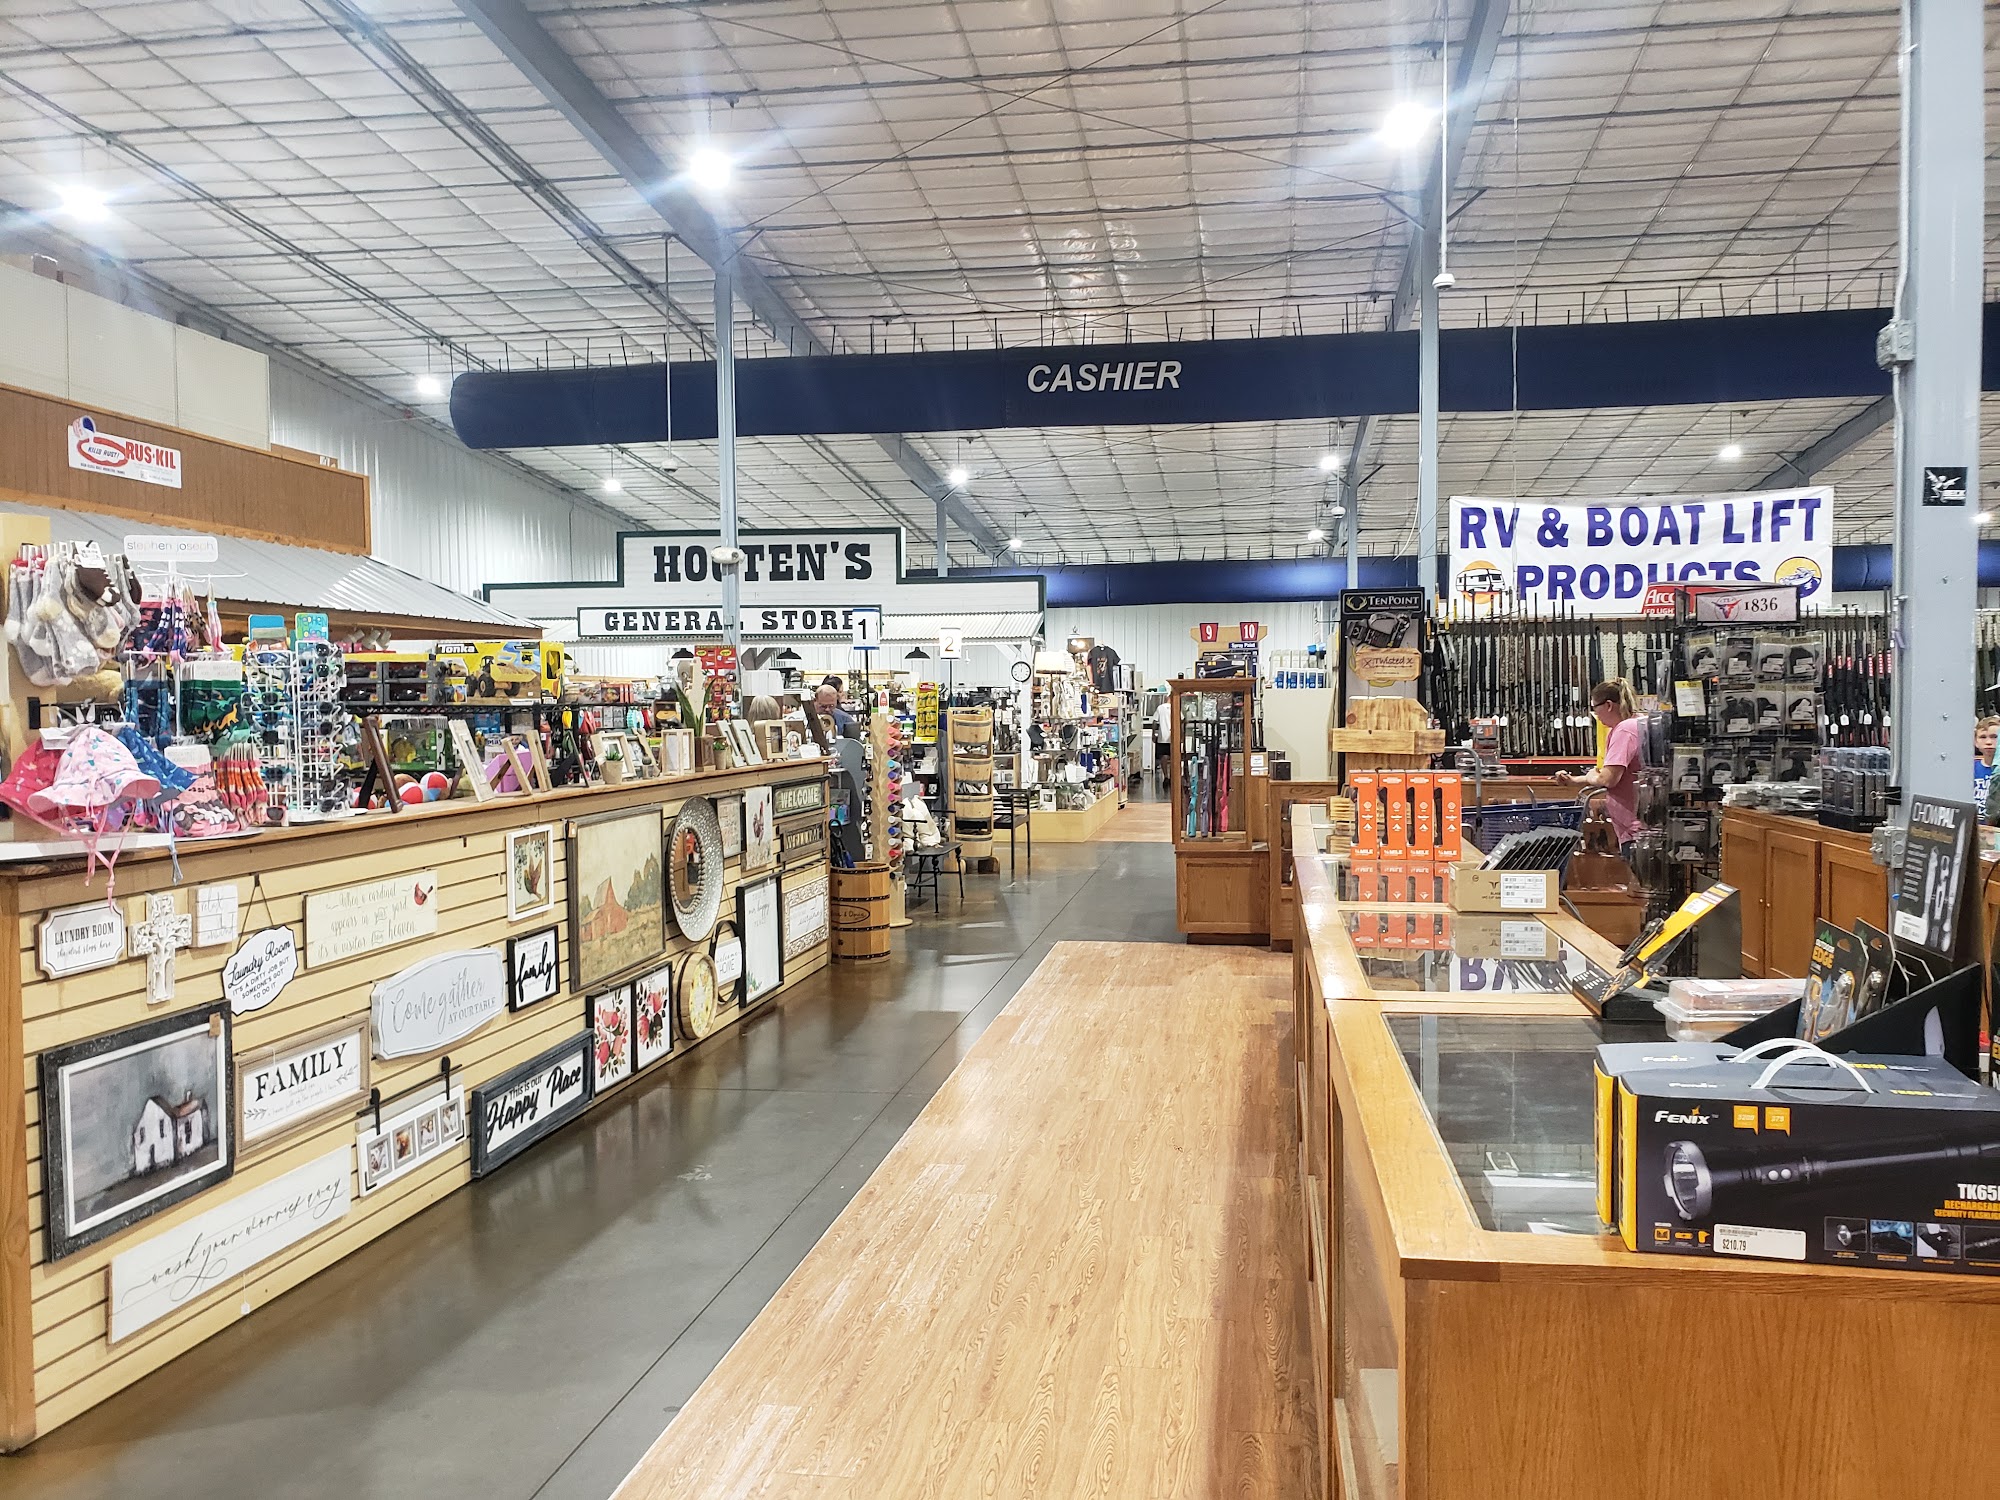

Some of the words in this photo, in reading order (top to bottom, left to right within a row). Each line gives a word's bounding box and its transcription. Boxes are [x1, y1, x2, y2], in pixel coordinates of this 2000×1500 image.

[1027, 360, 1182, 393] CASHIER
[87, 446, 103, 456] KILLS
[1459, 506, 1521, 549] RV
[1536, 507, 1570, 548] &
[1586, 504, 1707, 547] BOAT
[1722, 498, 1821, 544] LIFT
[127, 540, 172, 555] stephen
[1516, 560, 1762, 600] PRODUCTS
[1744, 597, 1778, 612] 1836
[604, 610, 743, 632] GENERA
[857, 618, 867, 640] 1
[1243, 623, 1255, 639] 10
[1205, 625, 1213, 640] 9
[438, 644, 476, 654] Tonka
[944, 636, 954, 652] 2
[1374, 656, 1405, 665] Twisted
[781, 787, 821, 809] WELCOME
[368, 882, 396, 901] cardinal
[54, 926, 90, 946] LAUNDRY
[92, 921, 114, 938] ROOM
[330, 915, 358, 937] appears
[227, 955, 263, 990] Laundry
[265, 940, 291, 962] Room
[1812, 945, 1835, 969] EDGE
[232, 985, 244, 997] IT'S
[250, 971, 266, 985] DIRTY
[267, 963, 278, 975] JOB
[279, 956, 290, 967] BUT
[516, 941, 556, 1003] family
[241, 977, 272, 1000] SOMEONE'S
[272, 968, 284, 979] GOT
[253, 992, 261, 1000] TO
[261, 986, 270, 995] DO
[271, 981, 277, 990] IT
[390, 988, 437, 1034] Come
[438, 967, 485, 1035] gather
[447, 1011, 459, 1025] AT
[459, 1004, 474, 1020] OUR
[474, 996, 496, 1016] TABLE
[255, 1042, 347, 1103] FAMILY
[509, 1083, 524, 1100] This
[524, 1082, 530, 1092] is
[530, 1075, 543, 1089] our
[486, 1088, 540, 1145] Happy
[546, 1065, 581, 1108] Place
[1933, 1208, 1967, 1219] SECURITY
[1722, 1238, 1747, 1251] $210.79
